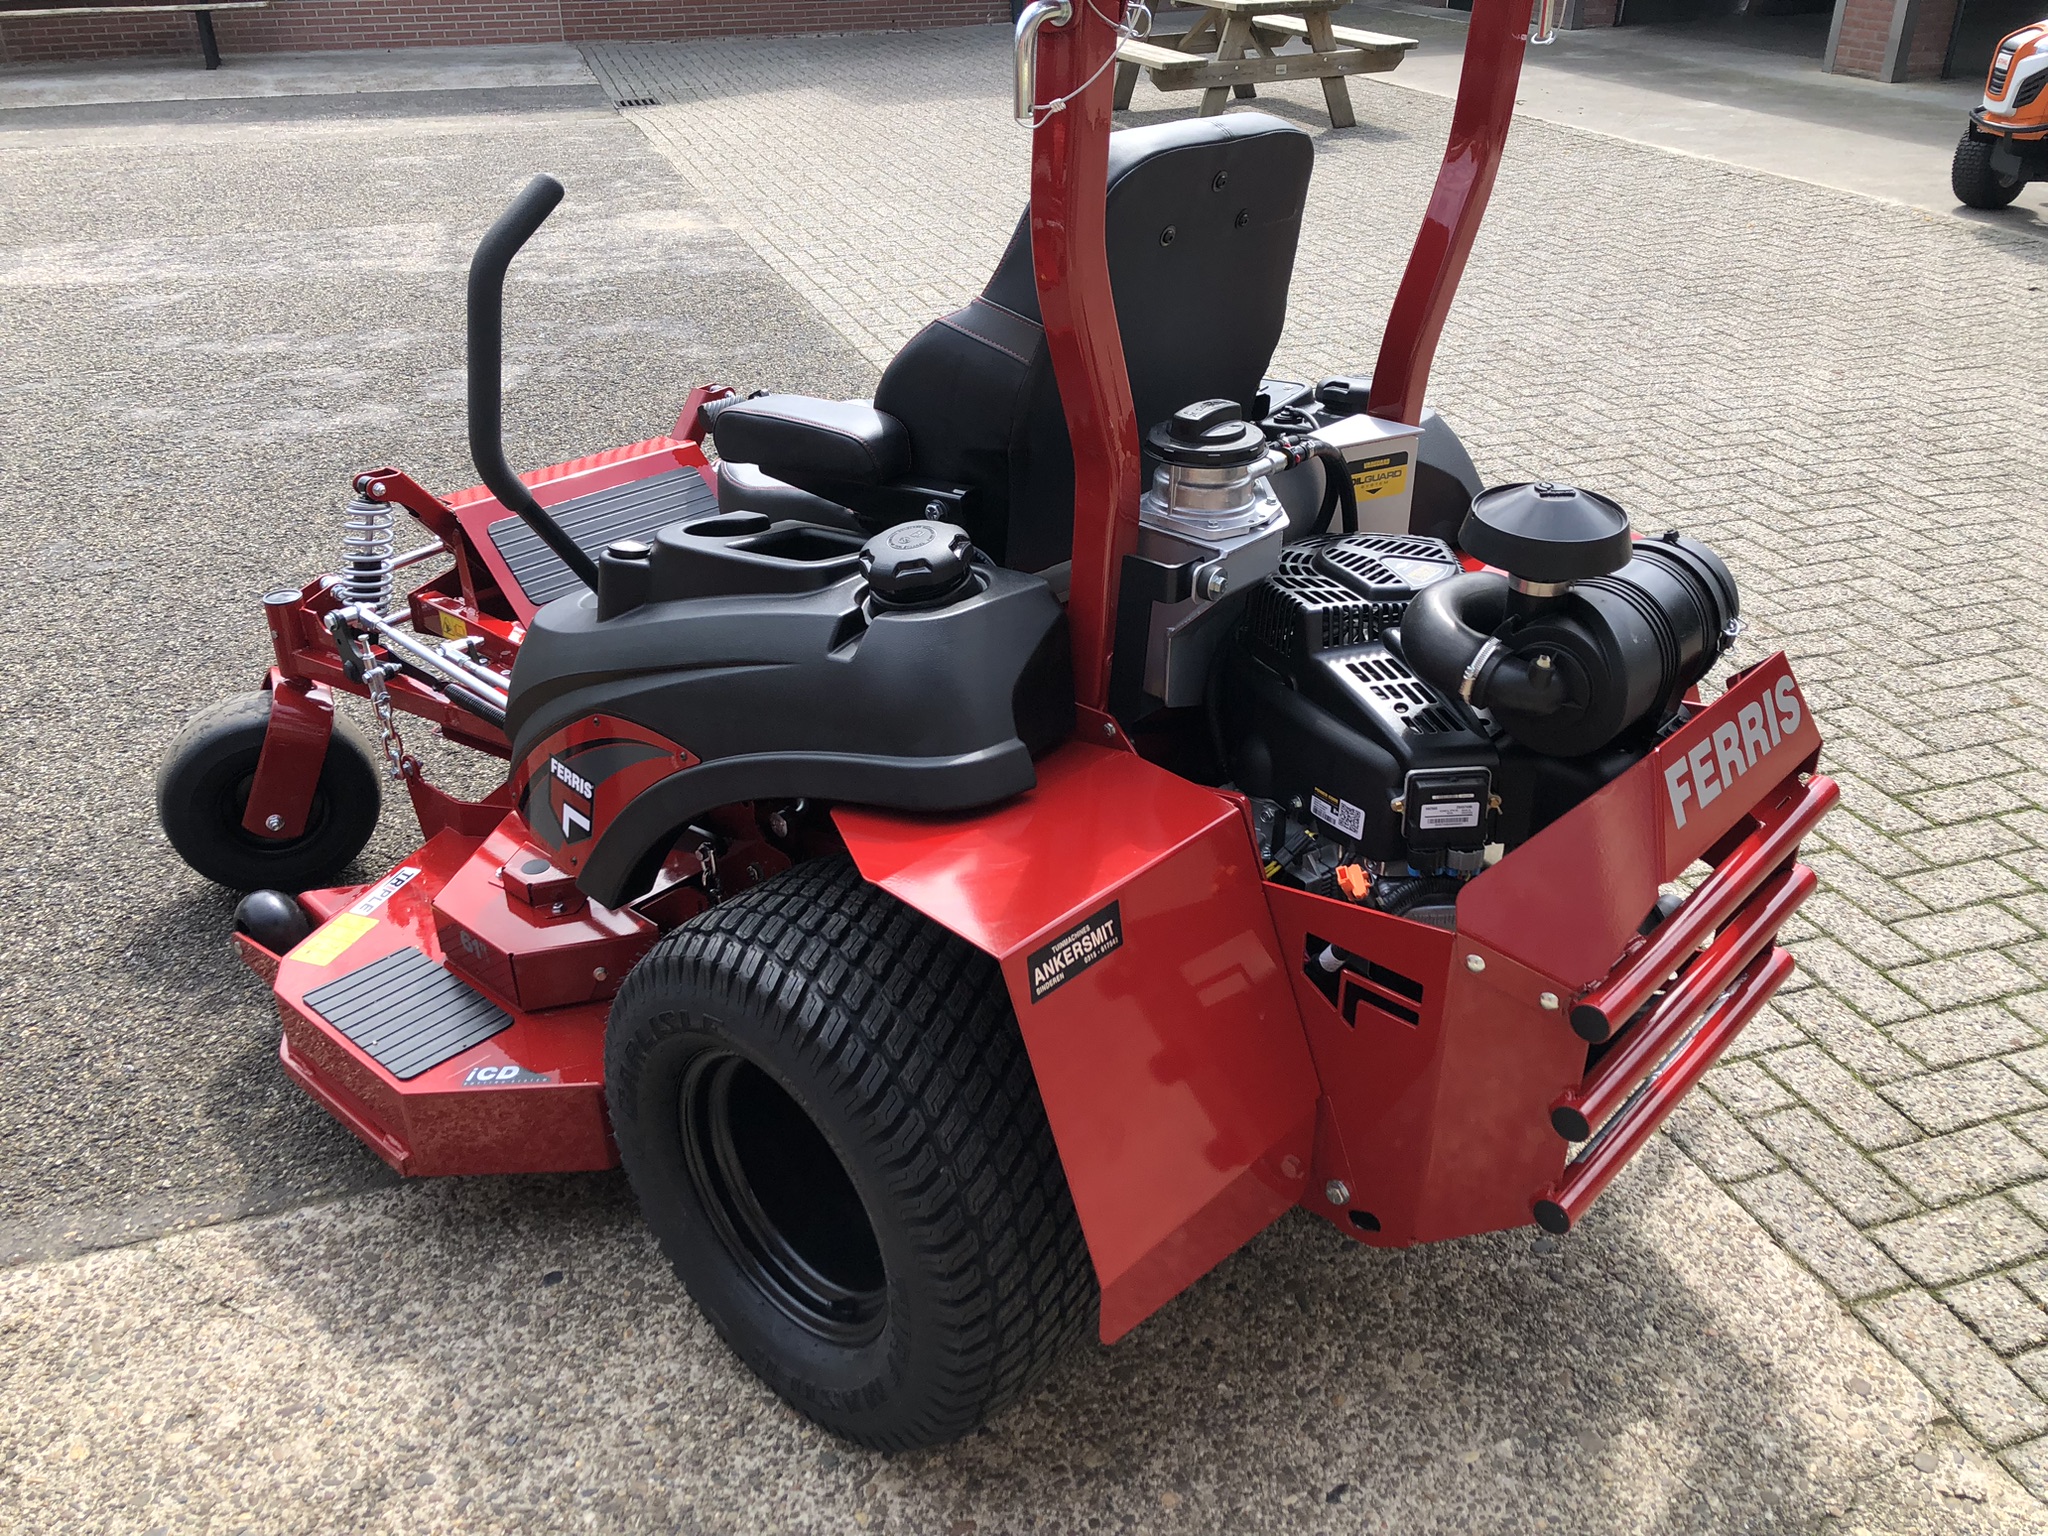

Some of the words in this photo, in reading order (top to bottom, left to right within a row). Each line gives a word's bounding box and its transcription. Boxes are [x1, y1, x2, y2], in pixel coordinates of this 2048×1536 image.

[1664, 675, 1801, 830] FERRIS
[551, 757, 593, 799] FERRIS
[360, 872, 414, 912] TRIPLE
[1034, 919, 1114, 987] ANKERSMIT
[1051, 924, 1091, 954] TUINMACHINES
[466, 1065, 520, 1082] iCD
